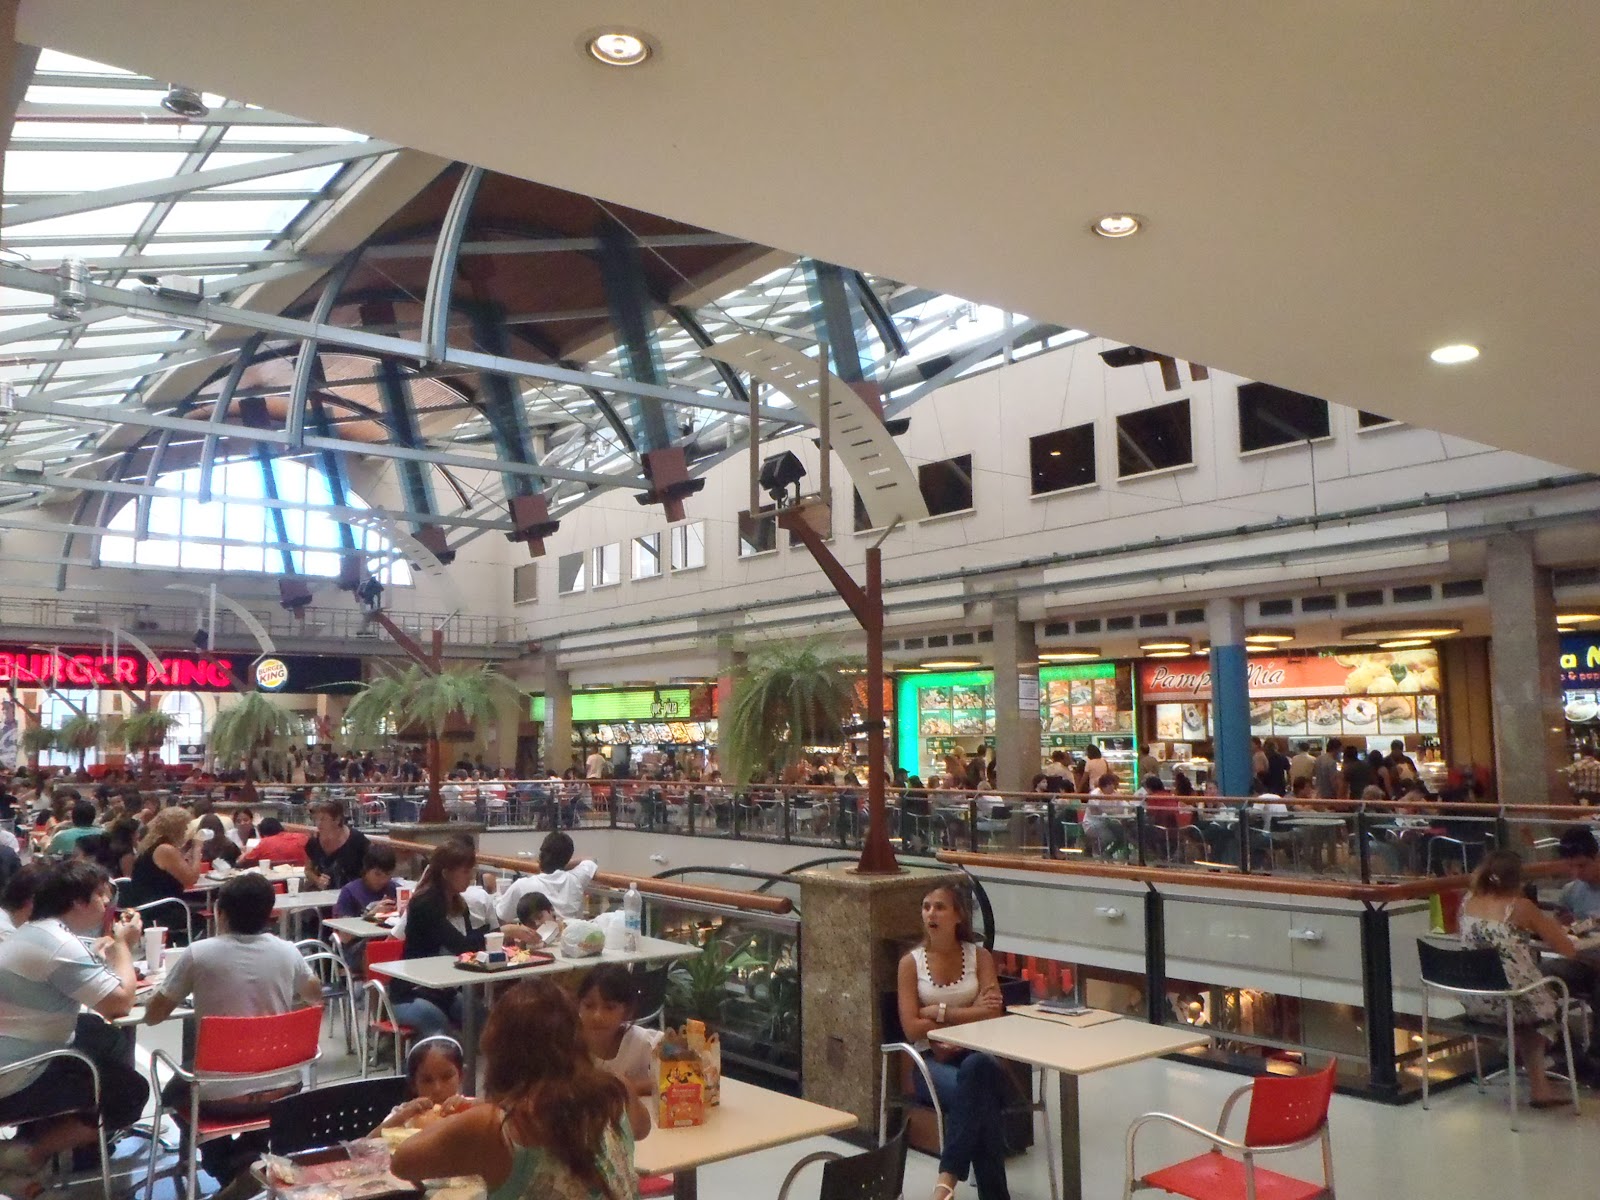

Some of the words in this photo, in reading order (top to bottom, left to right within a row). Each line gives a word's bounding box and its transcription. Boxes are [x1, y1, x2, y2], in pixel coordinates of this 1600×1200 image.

[0, 652, 138, 684] BURGER
[147, 657, 232, 687] KING
[258, 664, 284, 676] BURGER
[260, 669, 285, 683] KING
